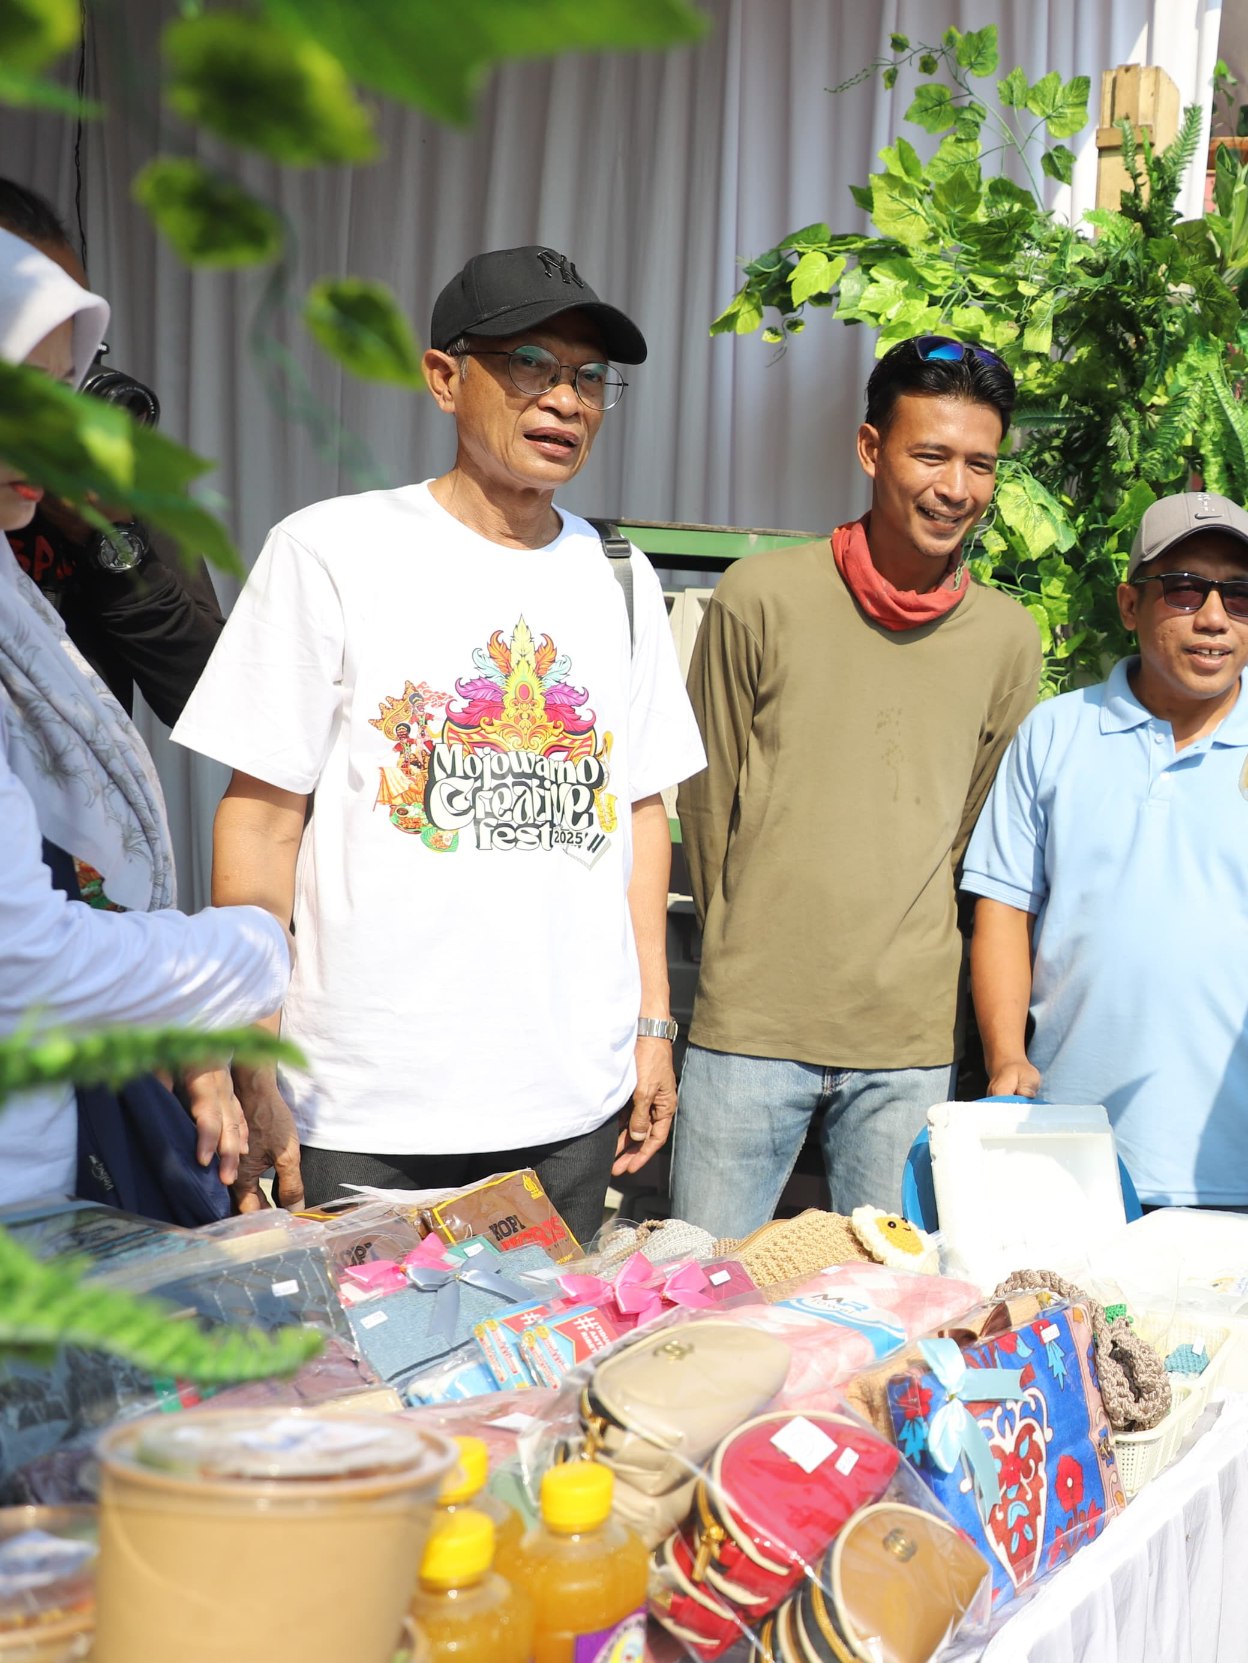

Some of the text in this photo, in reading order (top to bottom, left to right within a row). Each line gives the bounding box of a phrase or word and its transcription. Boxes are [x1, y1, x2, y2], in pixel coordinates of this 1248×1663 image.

[433, 743, 600, 791] Mojowarno
[430, 777, 595, 831] Creative
[489, 1215, 526, 1241] KOPI
